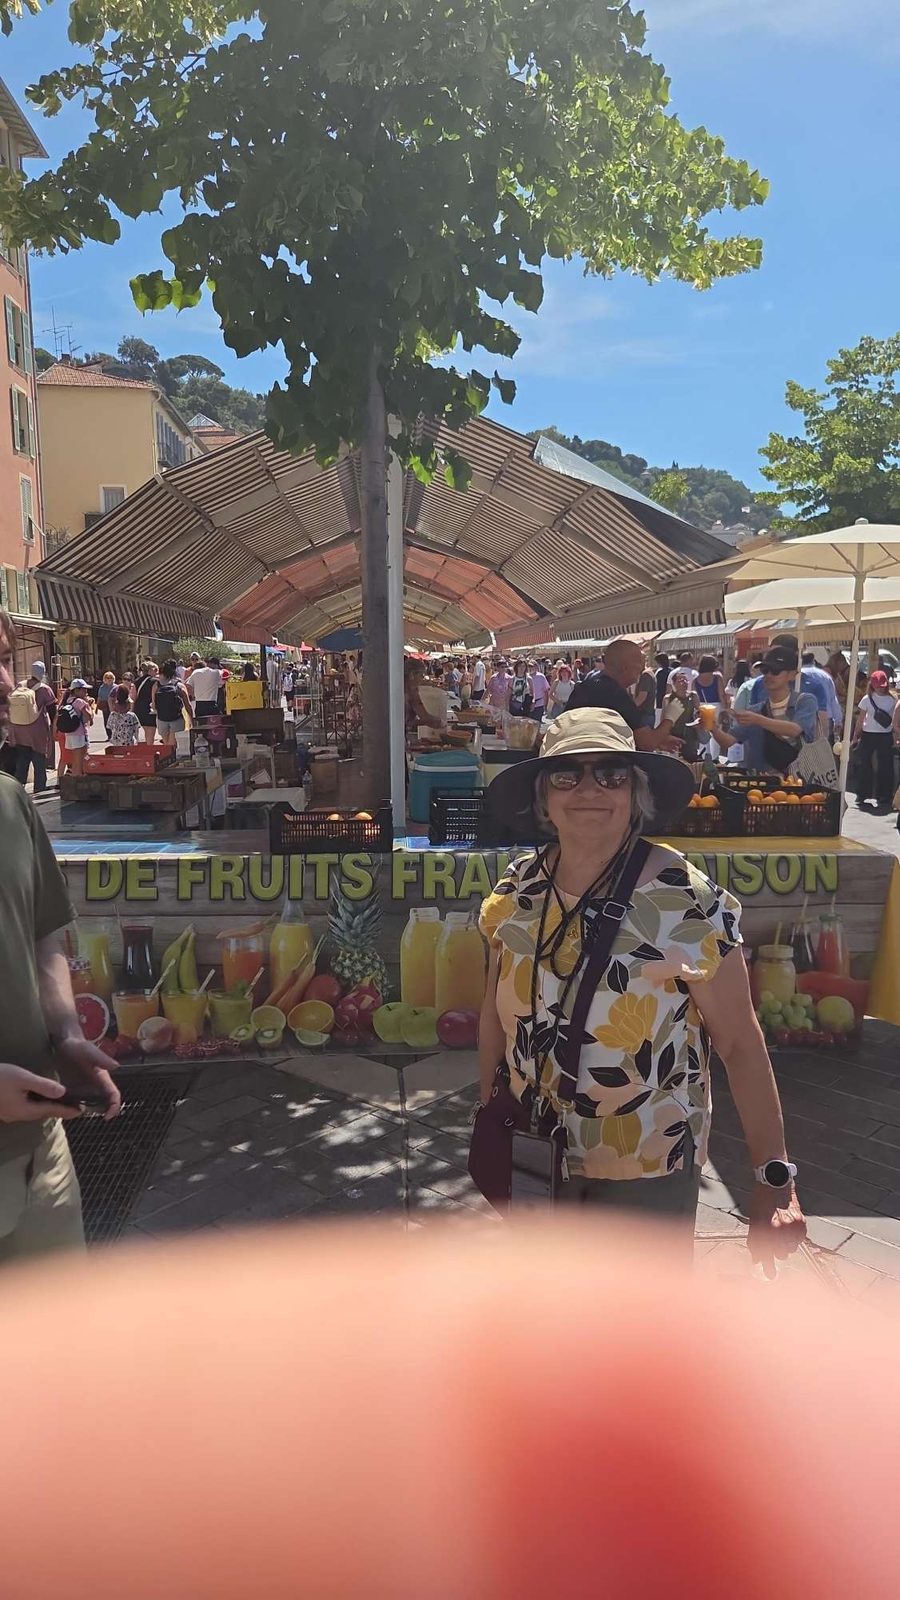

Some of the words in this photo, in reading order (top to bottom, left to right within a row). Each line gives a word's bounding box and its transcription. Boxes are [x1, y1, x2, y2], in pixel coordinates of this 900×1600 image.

[86, 858, 158, 900] DE
[177, 853, 373, 900] FRUITS
[392, 852, 535, 899] FRA
[686, 852, 838, 895] ISON
